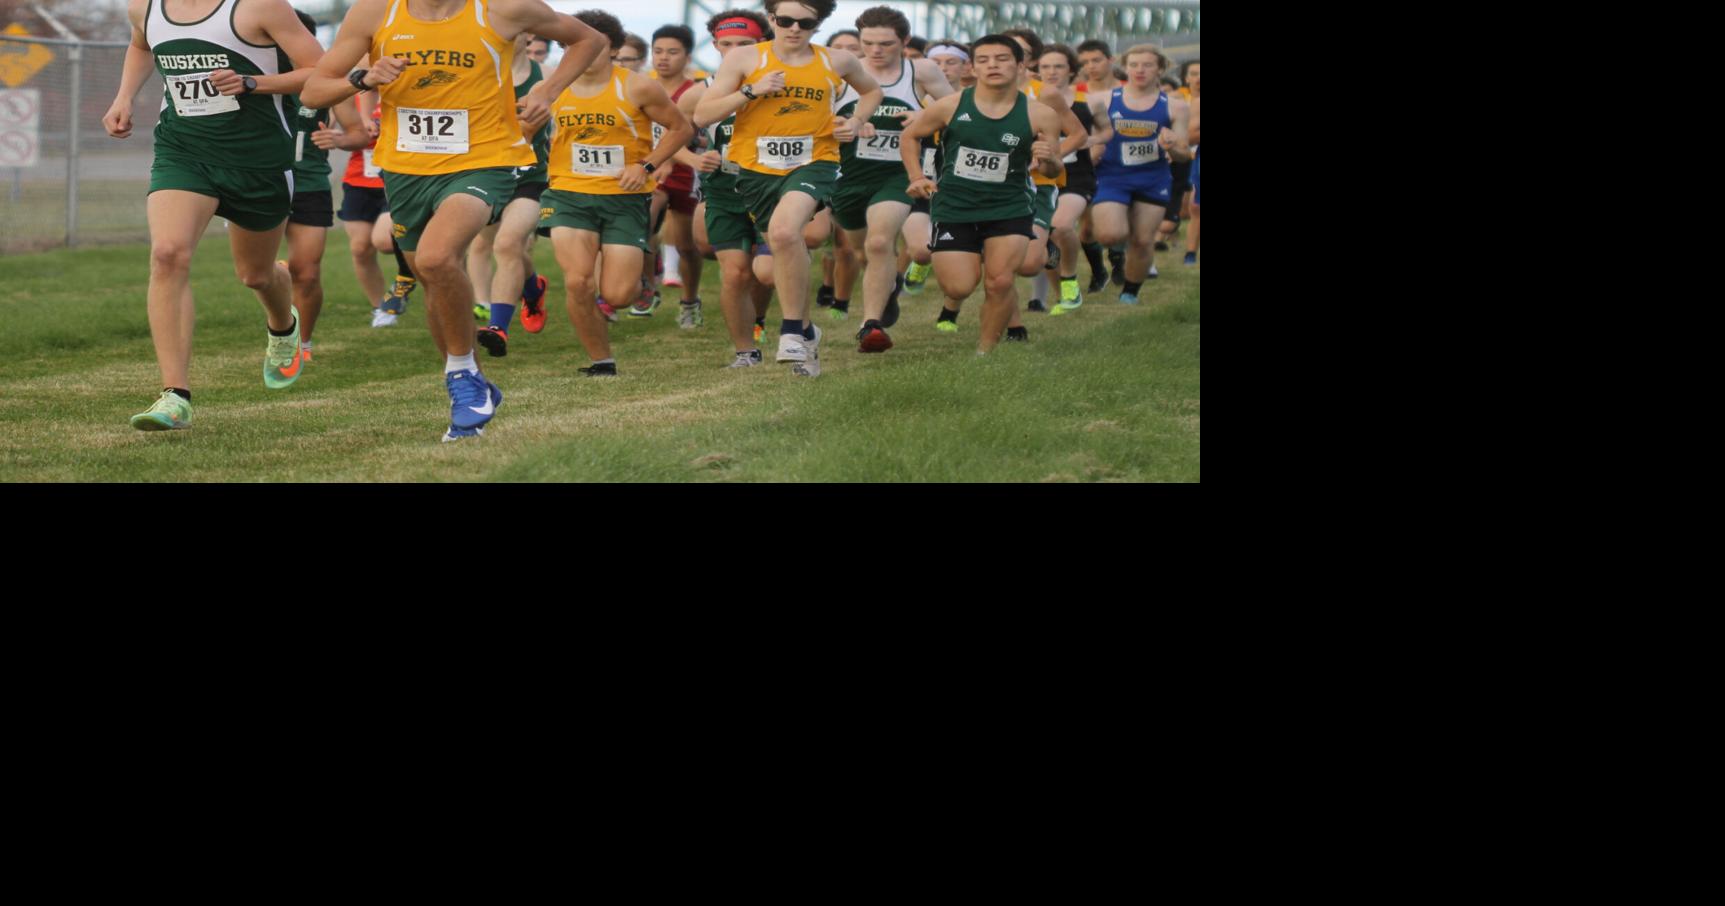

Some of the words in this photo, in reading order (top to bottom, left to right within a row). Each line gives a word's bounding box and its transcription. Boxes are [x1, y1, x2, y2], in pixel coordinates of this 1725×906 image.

[157, 54, 229, 70] HUSKIES
[175, 78, 219, 99] 270
[408, 114, 454, 136] 312
[558, 113, 616, 127] FLYERS
[767, 142, 804, 157] 308
[867, 135, 900, 149] 276
[579, 149, 611, 164] 311
[965, 153, 1000, 170] 346
